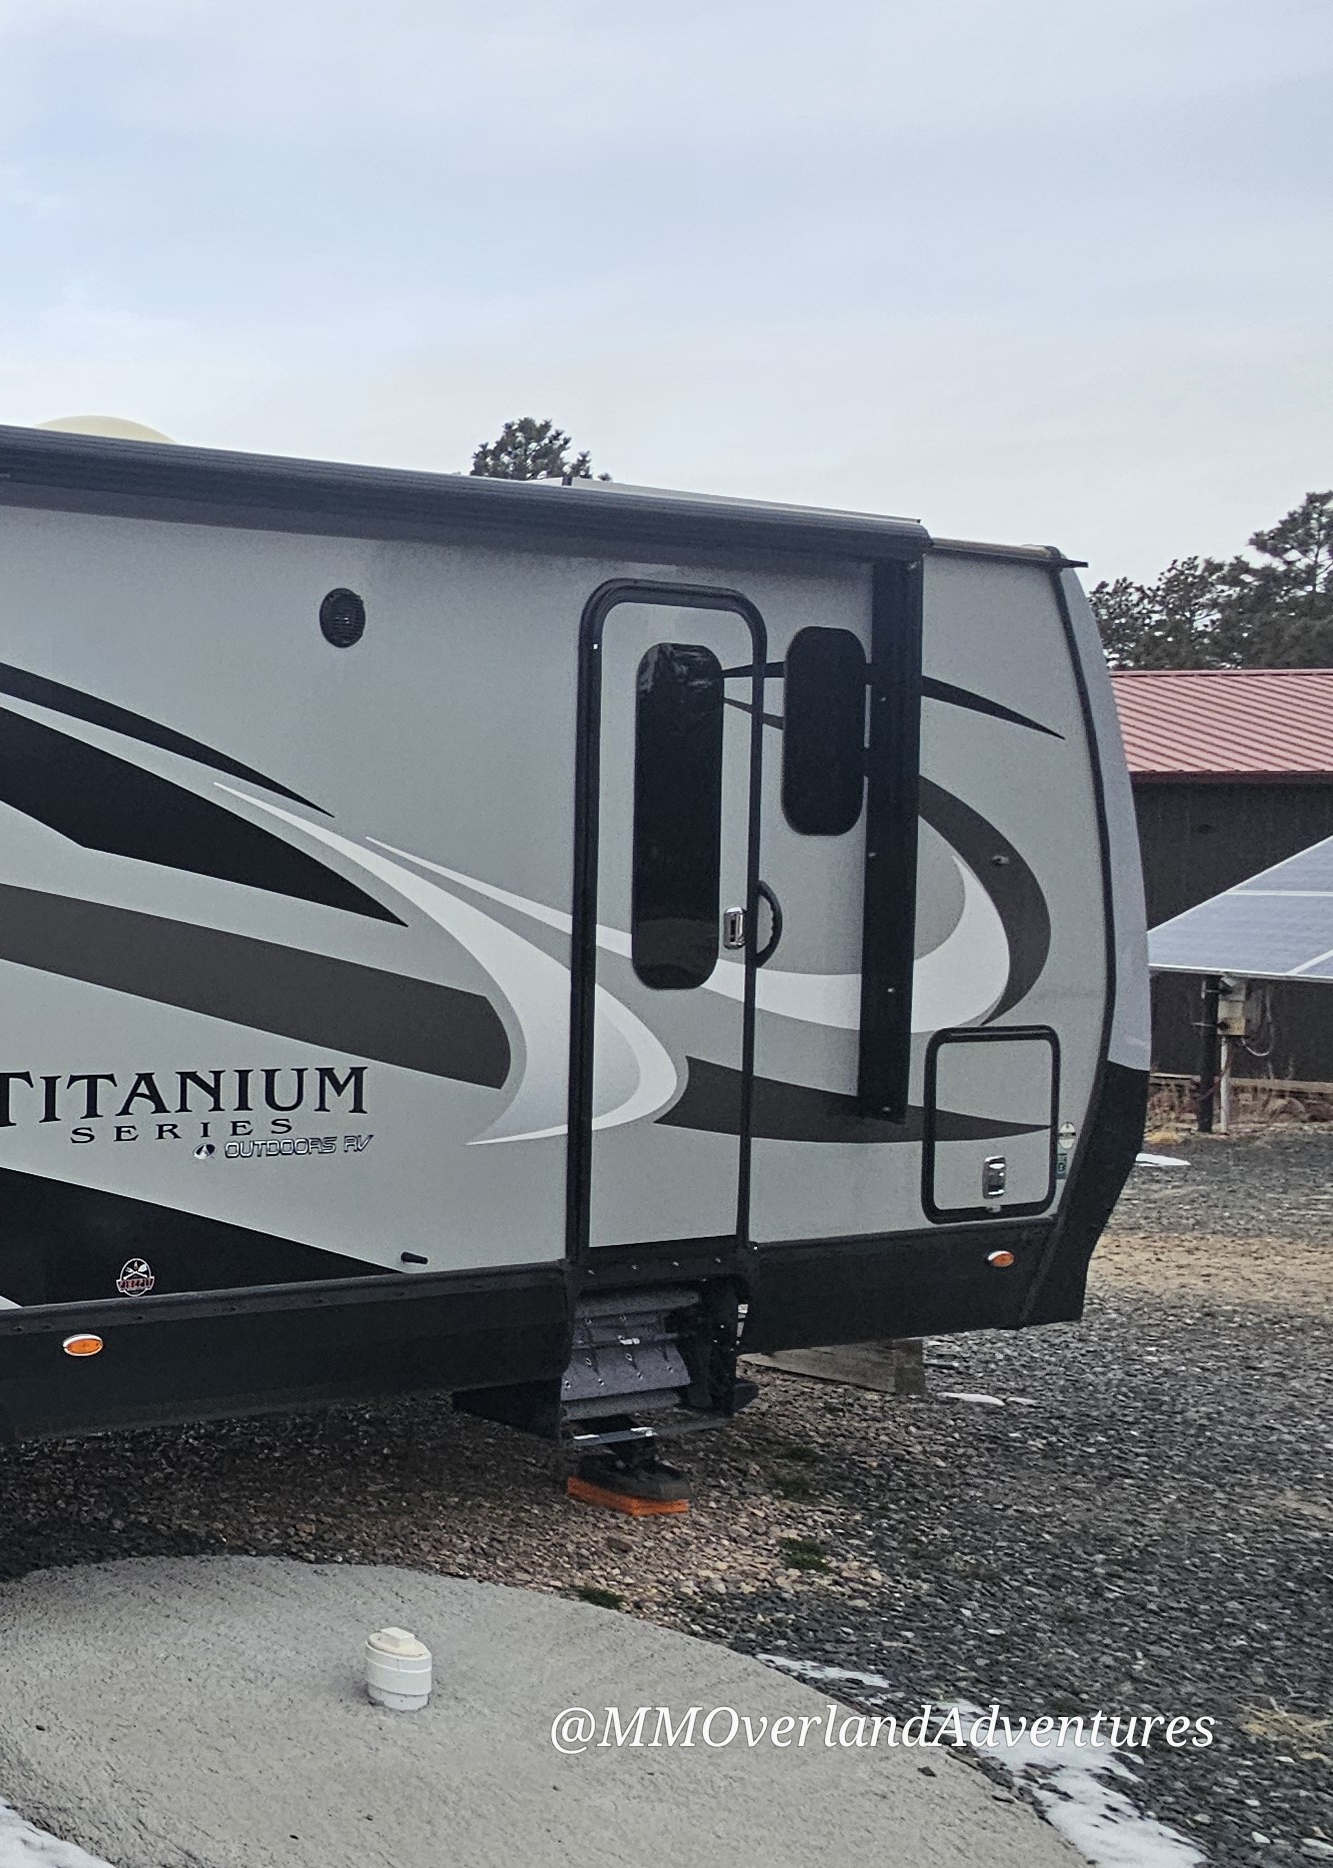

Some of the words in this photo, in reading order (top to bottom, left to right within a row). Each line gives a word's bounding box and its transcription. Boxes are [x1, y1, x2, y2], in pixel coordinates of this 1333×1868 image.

[70, 1118, 293, 1144] SERIES
[225, 1136, 337, 1160] OUTDOORS
[343, 1134, 375, 1153] RV
